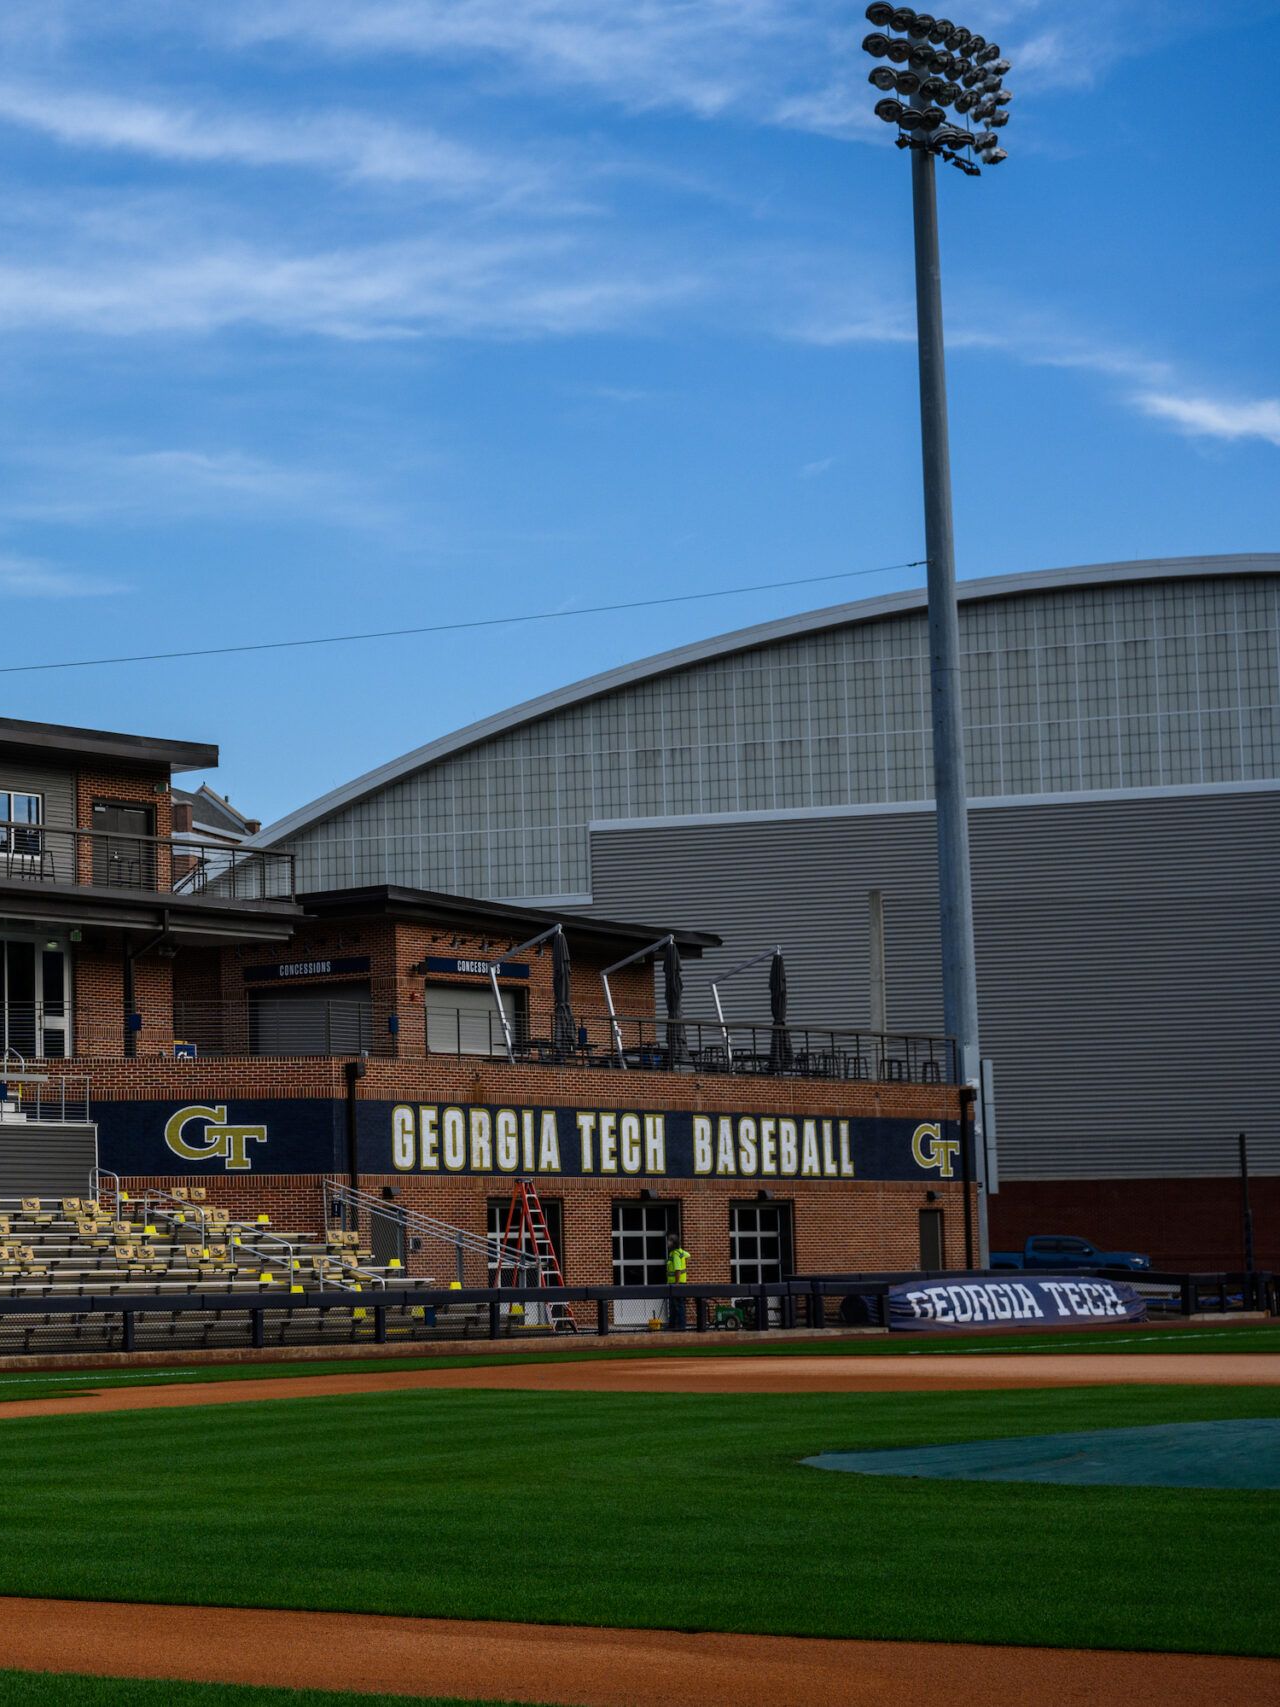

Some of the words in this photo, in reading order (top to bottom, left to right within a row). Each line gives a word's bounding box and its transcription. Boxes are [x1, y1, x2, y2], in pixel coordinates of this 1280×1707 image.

[279, 961, 331, 977] CONCESSIONS
[457, 960, 501, 974] CONCESSIS
[164, 1105, 267, 1169] GT
[392, 1104, 562, 1173] GEORGIA
[576, 1111, 666, 1175] TECH
[692, 1114, 855, 1177] BASEBALL
[912, 1122, 960, 1177] GT
[906, 1282, 1044, 1323] GEORGIA
[1039, 1282, 1126, 1316] TECH
